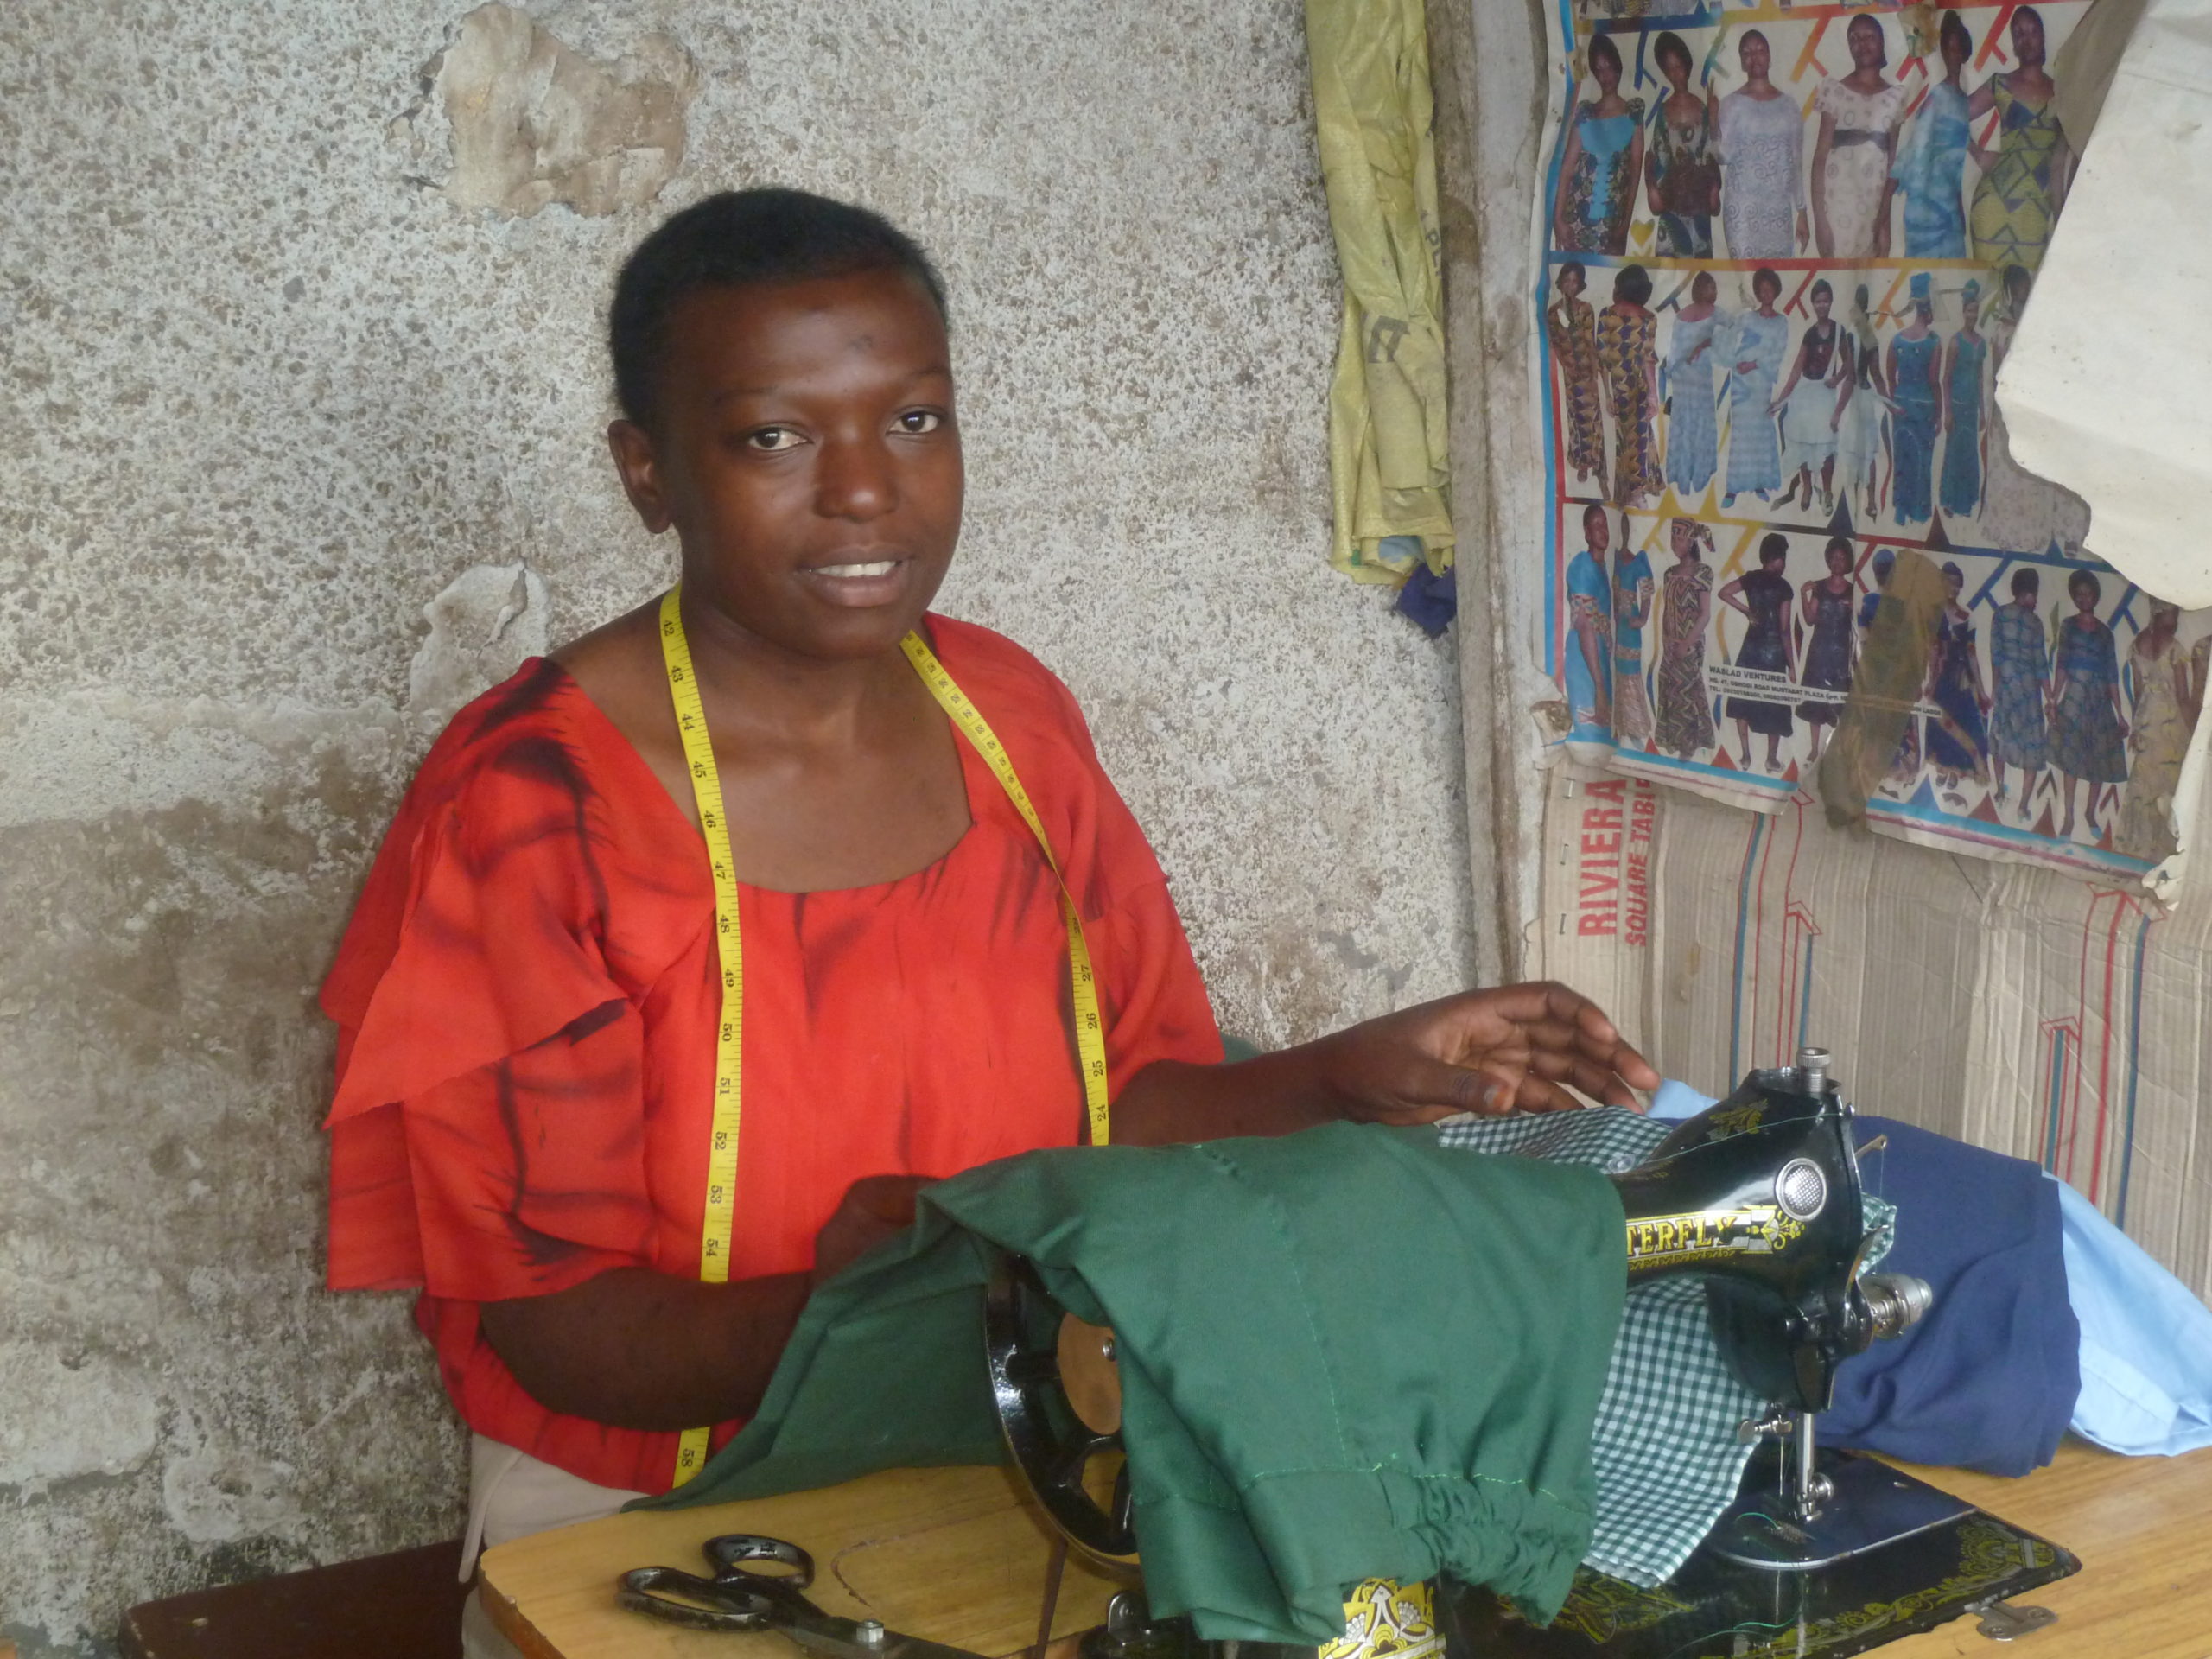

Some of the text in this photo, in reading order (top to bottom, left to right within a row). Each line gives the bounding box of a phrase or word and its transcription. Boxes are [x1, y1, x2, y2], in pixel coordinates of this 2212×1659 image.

[663, 620, 675, 637] 42
[671, 665, 684, 683] 43
[1744, 671, 1787, 683] VENTURES
[682, 714, 696, 731] 44
[693, 761, 707, 778] 45
[703, 810, 717, 829] 46
[1578, 779, 1627, 937] RIVIERA
[715, 861, 727, 880] 47
[1625, 852, 1649, 947] SQUARE
[720, 915, 730, 933] 48
[725, 969, 734, 988] 49
[1081, 965, 1091, 982] 27
[1087, 1013, 1098, 1029] 26
[721, 1023, 733, 1042] 50
[1092, 1060, 1103, 1077] 25
[720, 1077, 730, 1096] 51
[1097, 1104, 1107, 1122] 24
[715, 1131, 728, 1150] 52
[710, 1185, 723, 1204] 53
[705, 1238, 719, 1257] 54
[681, 1448, 695, 1468] 58
